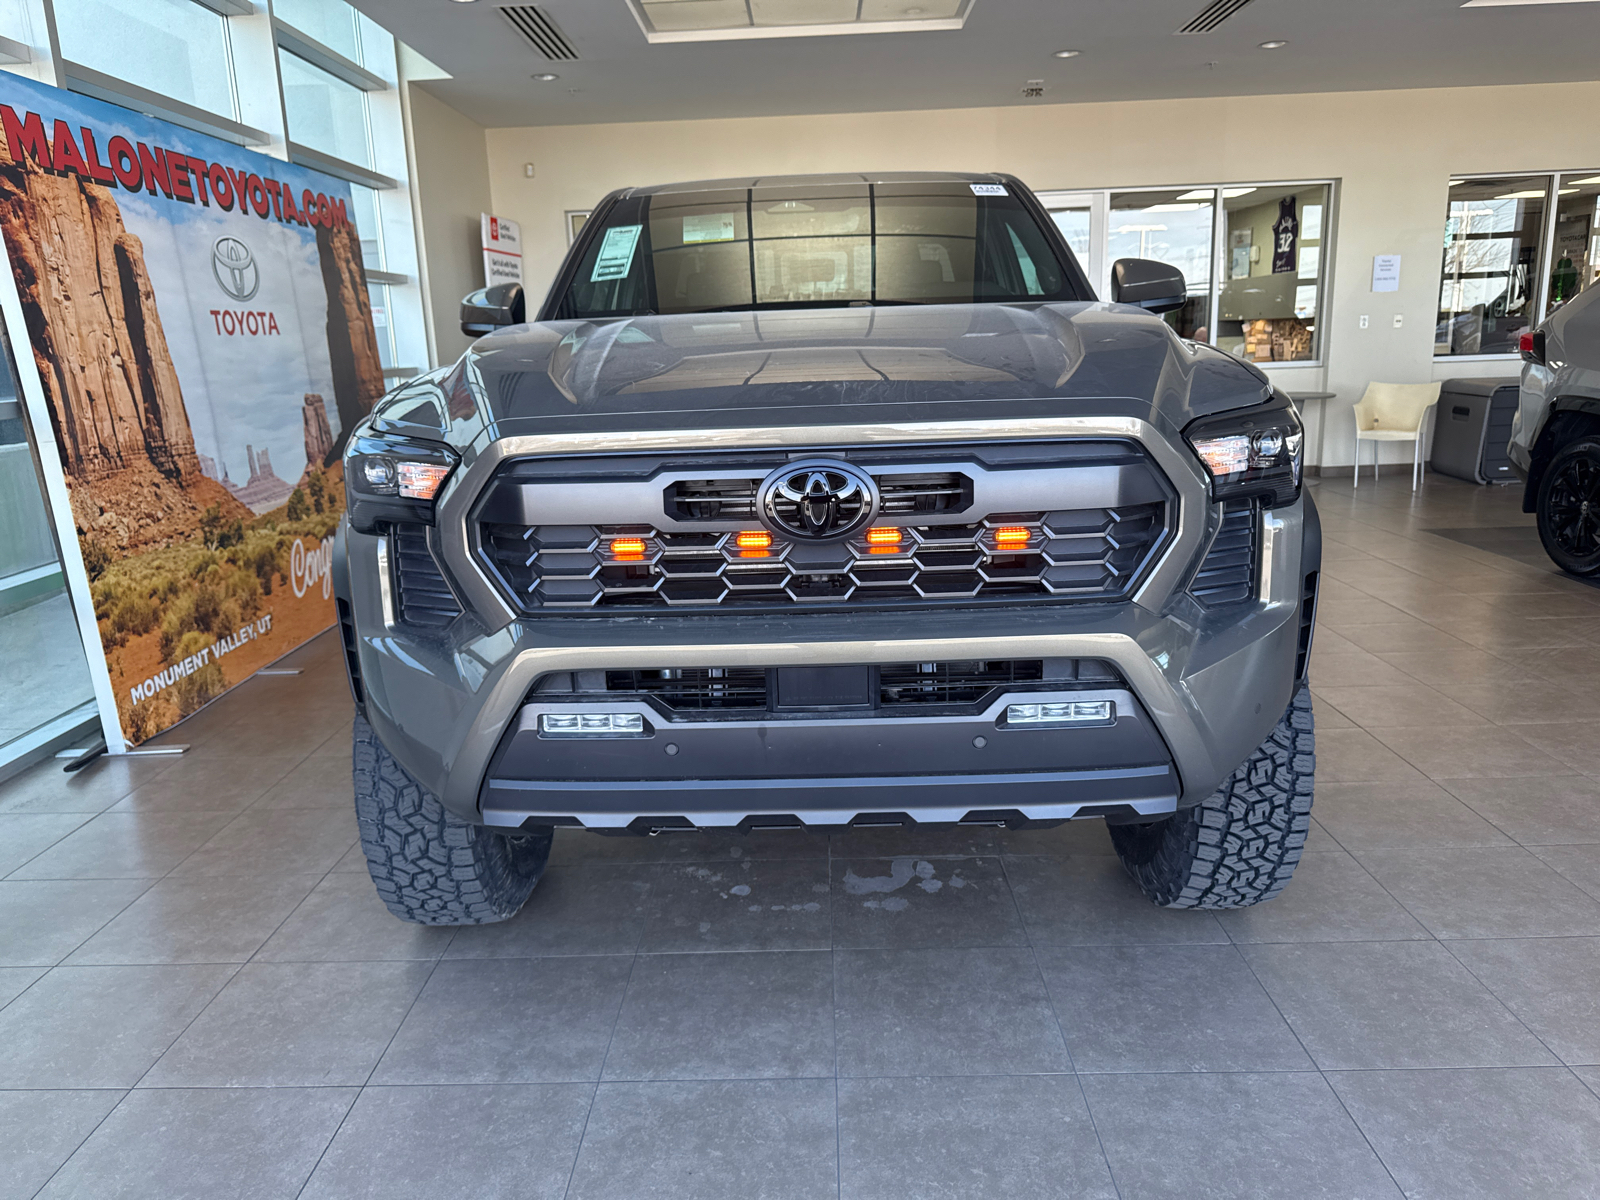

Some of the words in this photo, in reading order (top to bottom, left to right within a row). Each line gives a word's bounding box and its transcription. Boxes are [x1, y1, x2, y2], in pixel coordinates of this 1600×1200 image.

[0, 103, 351, 233] MALONETOYOTA.COM
[1277, 232, 1293, 253] 32
[210, 309, 281, 336] TOYOTA
[130, 647, 209, 706] MONUMENT
[210, 624, 258, 660] VALLEY,
[257, 614, 272, 634] UT
